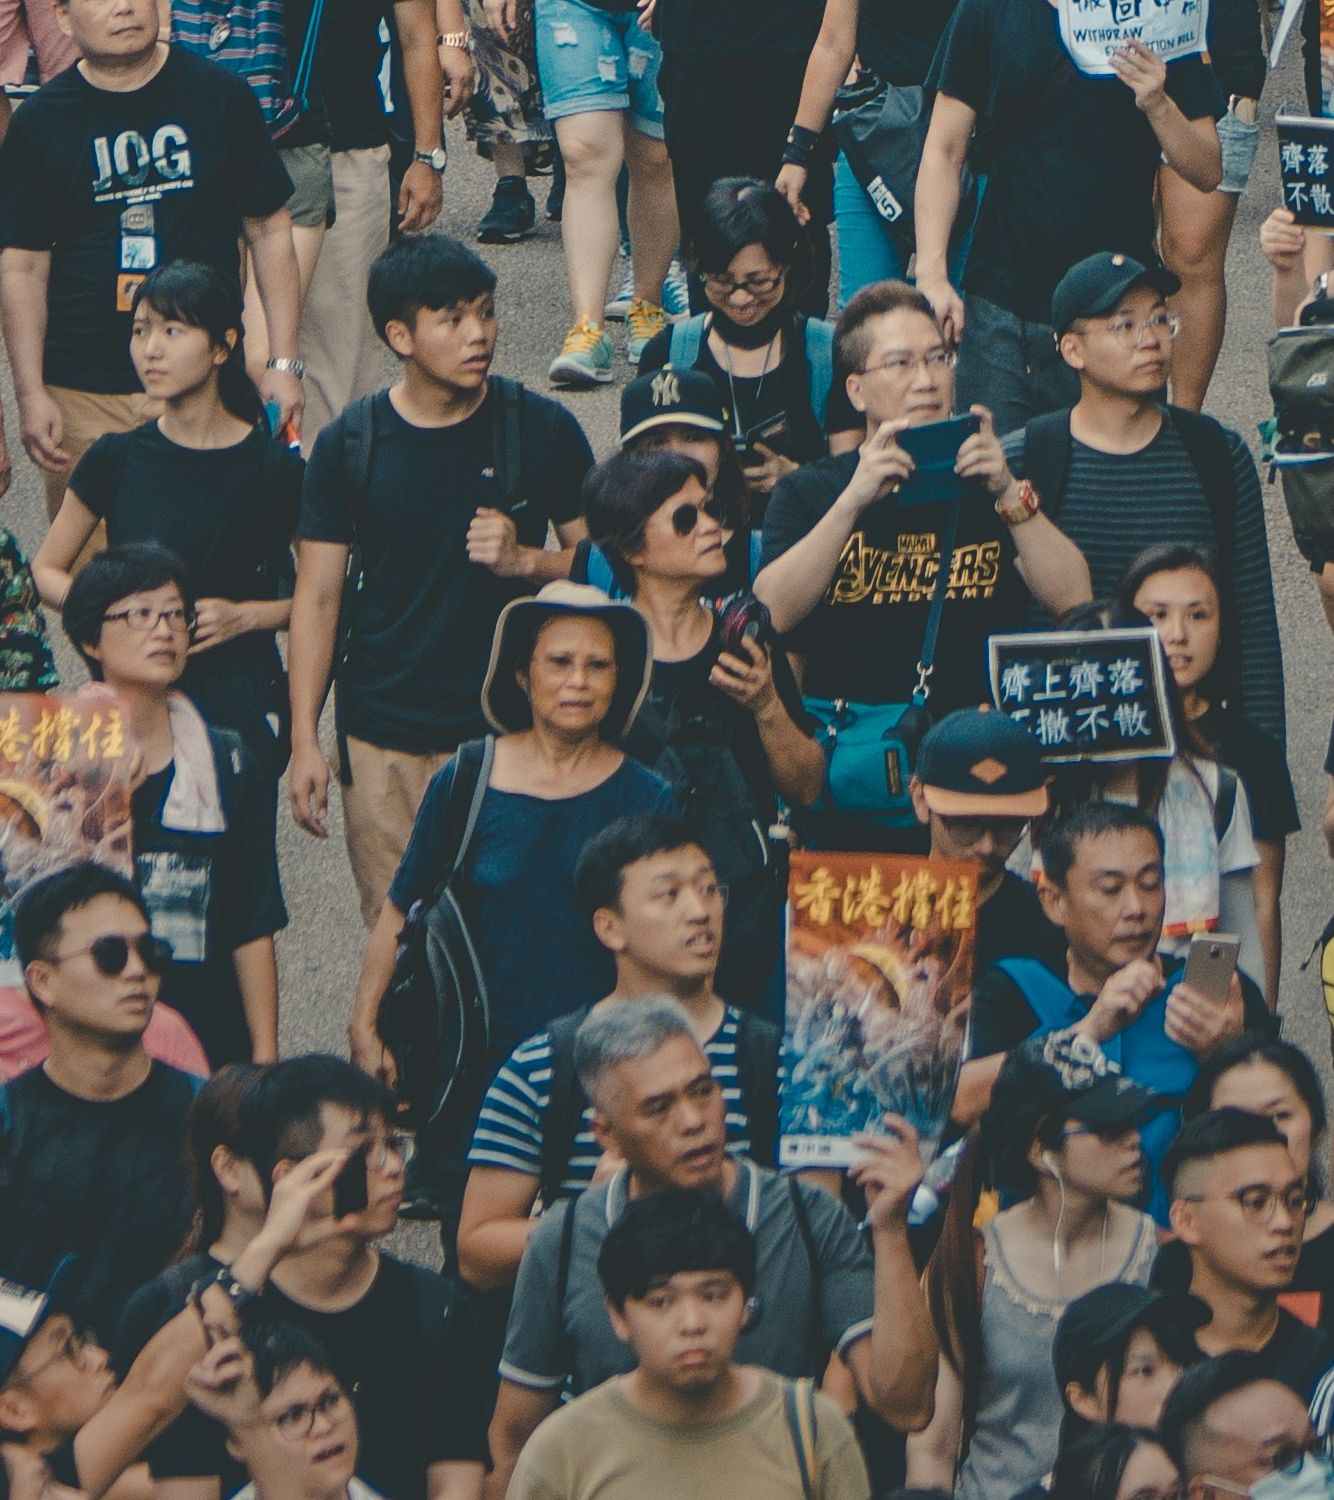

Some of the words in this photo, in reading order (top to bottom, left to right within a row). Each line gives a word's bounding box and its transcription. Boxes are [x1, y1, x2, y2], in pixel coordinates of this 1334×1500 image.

[1073, 26, 1144, 43] WITHDRAW
[92, 124, 191, 192] JOG
[831, 531, 1002, 605] AVENGERS
[1001, 657, 1141, 704] 齊上齊落
[793, 867, 972, 932] 香港撐住
